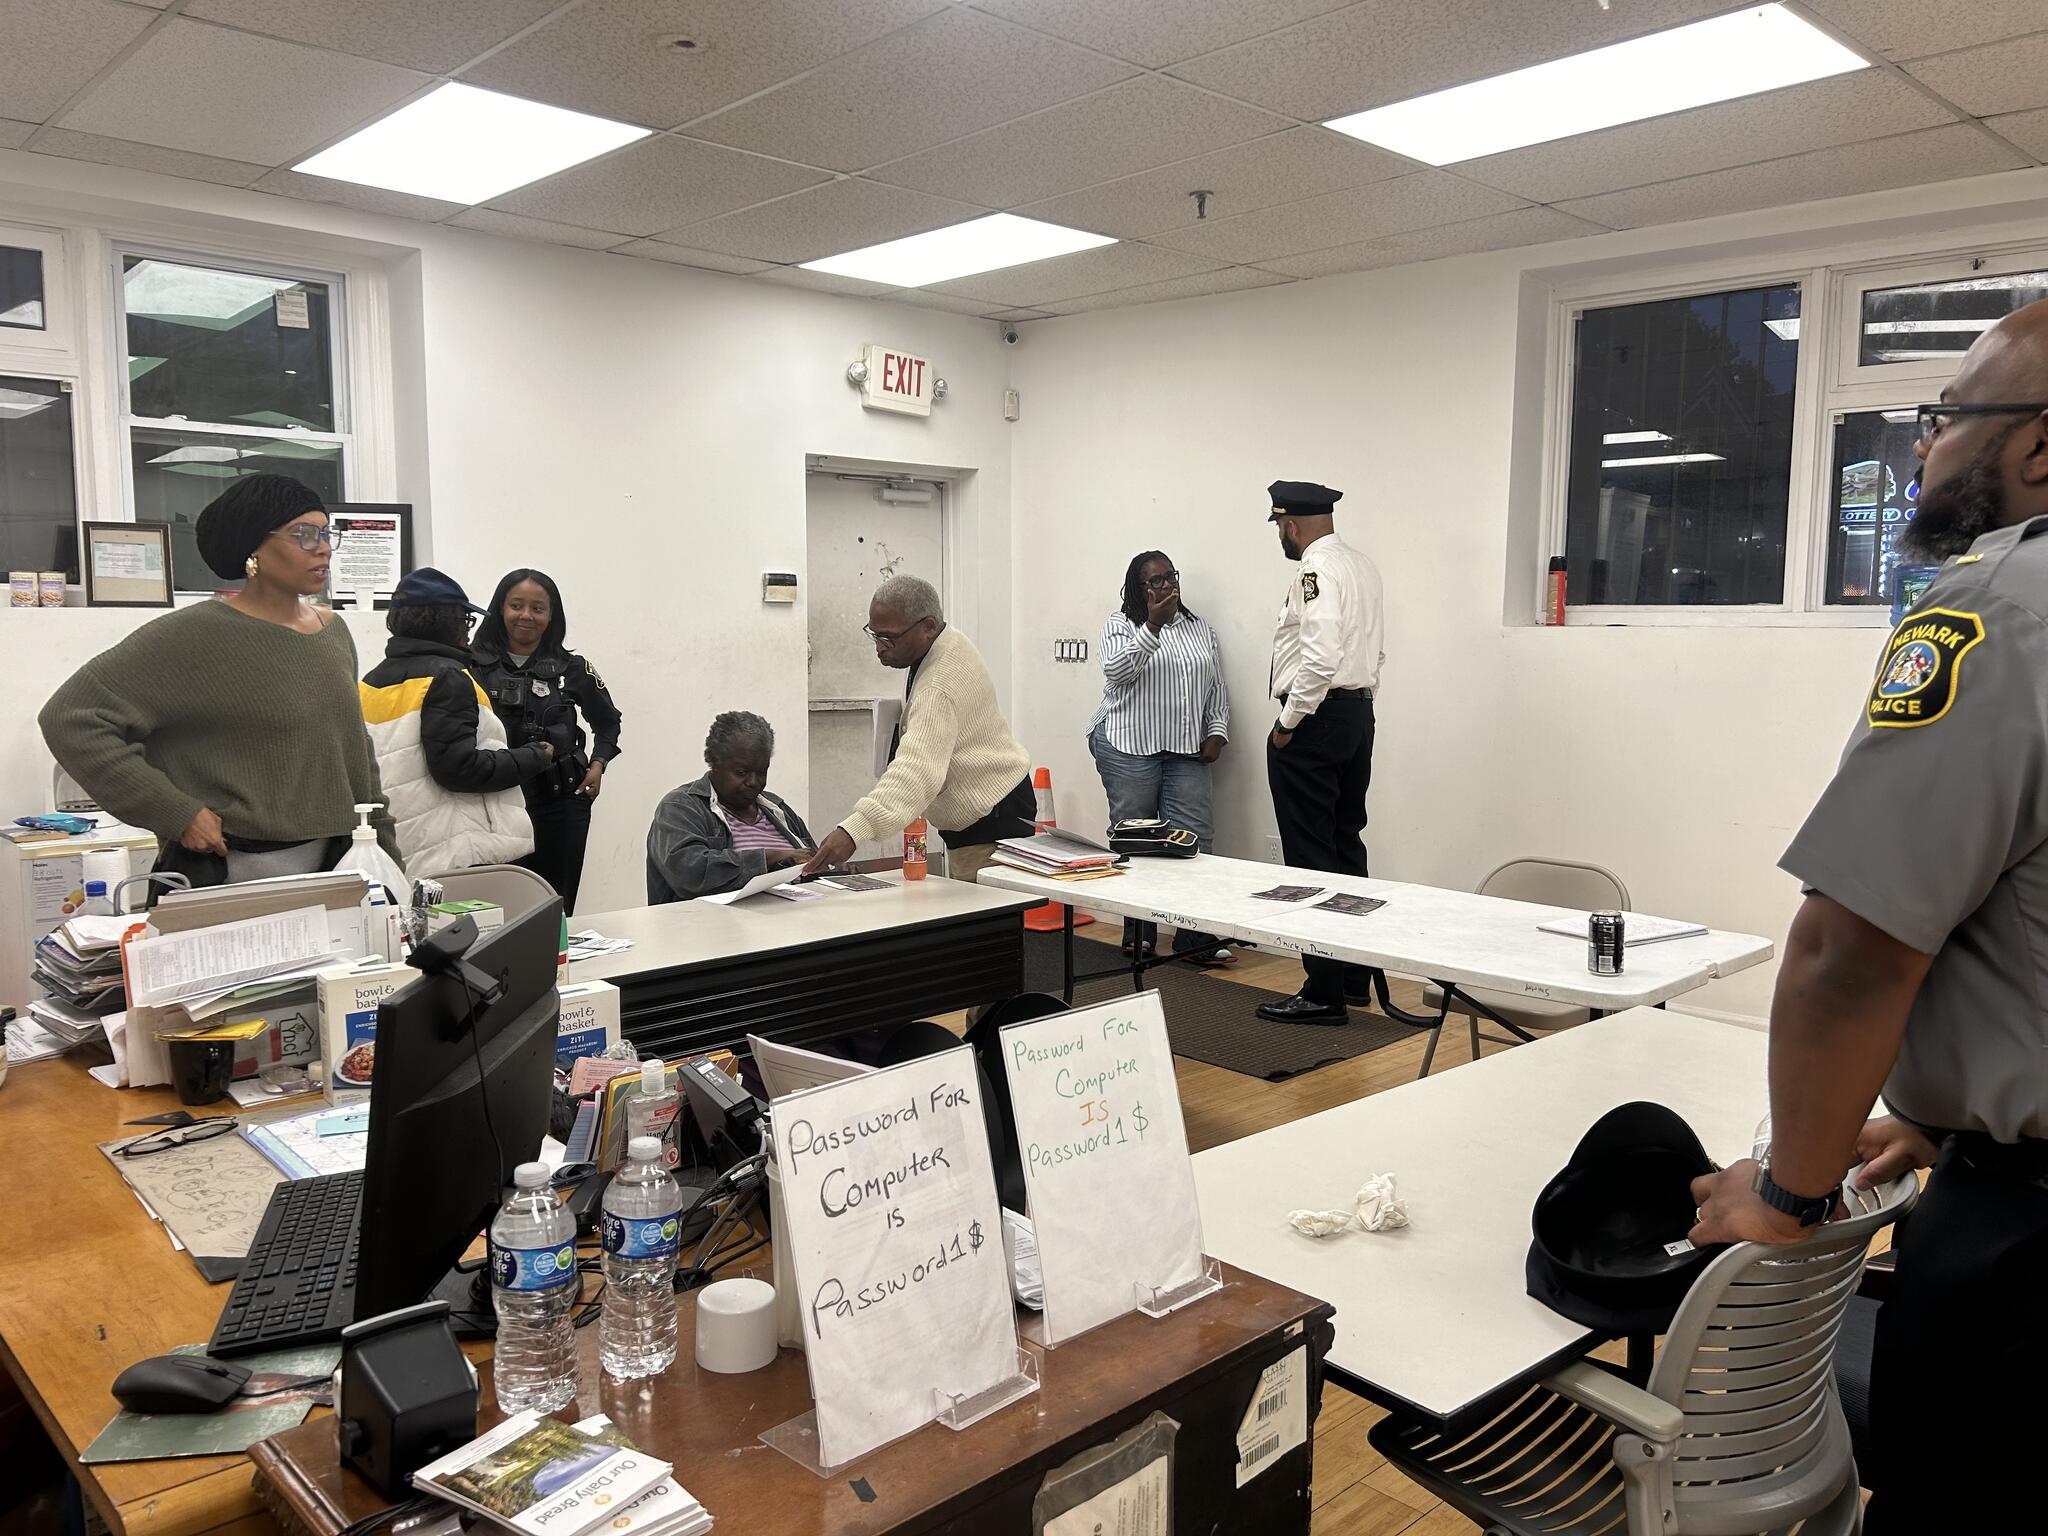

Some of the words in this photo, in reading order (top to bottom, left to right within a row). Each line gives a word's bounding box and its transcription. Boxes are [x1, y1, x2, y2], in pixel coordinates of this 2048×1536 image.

[883, 353, 925, 397] EXIT
[1893, 624, 1965, 650] NEWARK
[355, 986, 383, 998] bowl
[384, 985, 395, 994] &
[585, 1007, 595, 1016] &
[570, 1035, 585, 1044] ZITI
[1013, 1035, 1084, 1071] Password
[1079, 1100, 1109, 1127] IS
[787, 1097, 918, 1175] Password
[603, 1211, 620, 1229] Pure
[604, 1223, 617, 1240] Life
[492, 1244, 511, 1262] Pure
[493, 1258, 508, 1274] Life
[612, 1460, 637, 1478] Our
[577, 1475, 613, 1500] Daily
[534, 1496, 580, 1525] Bread
